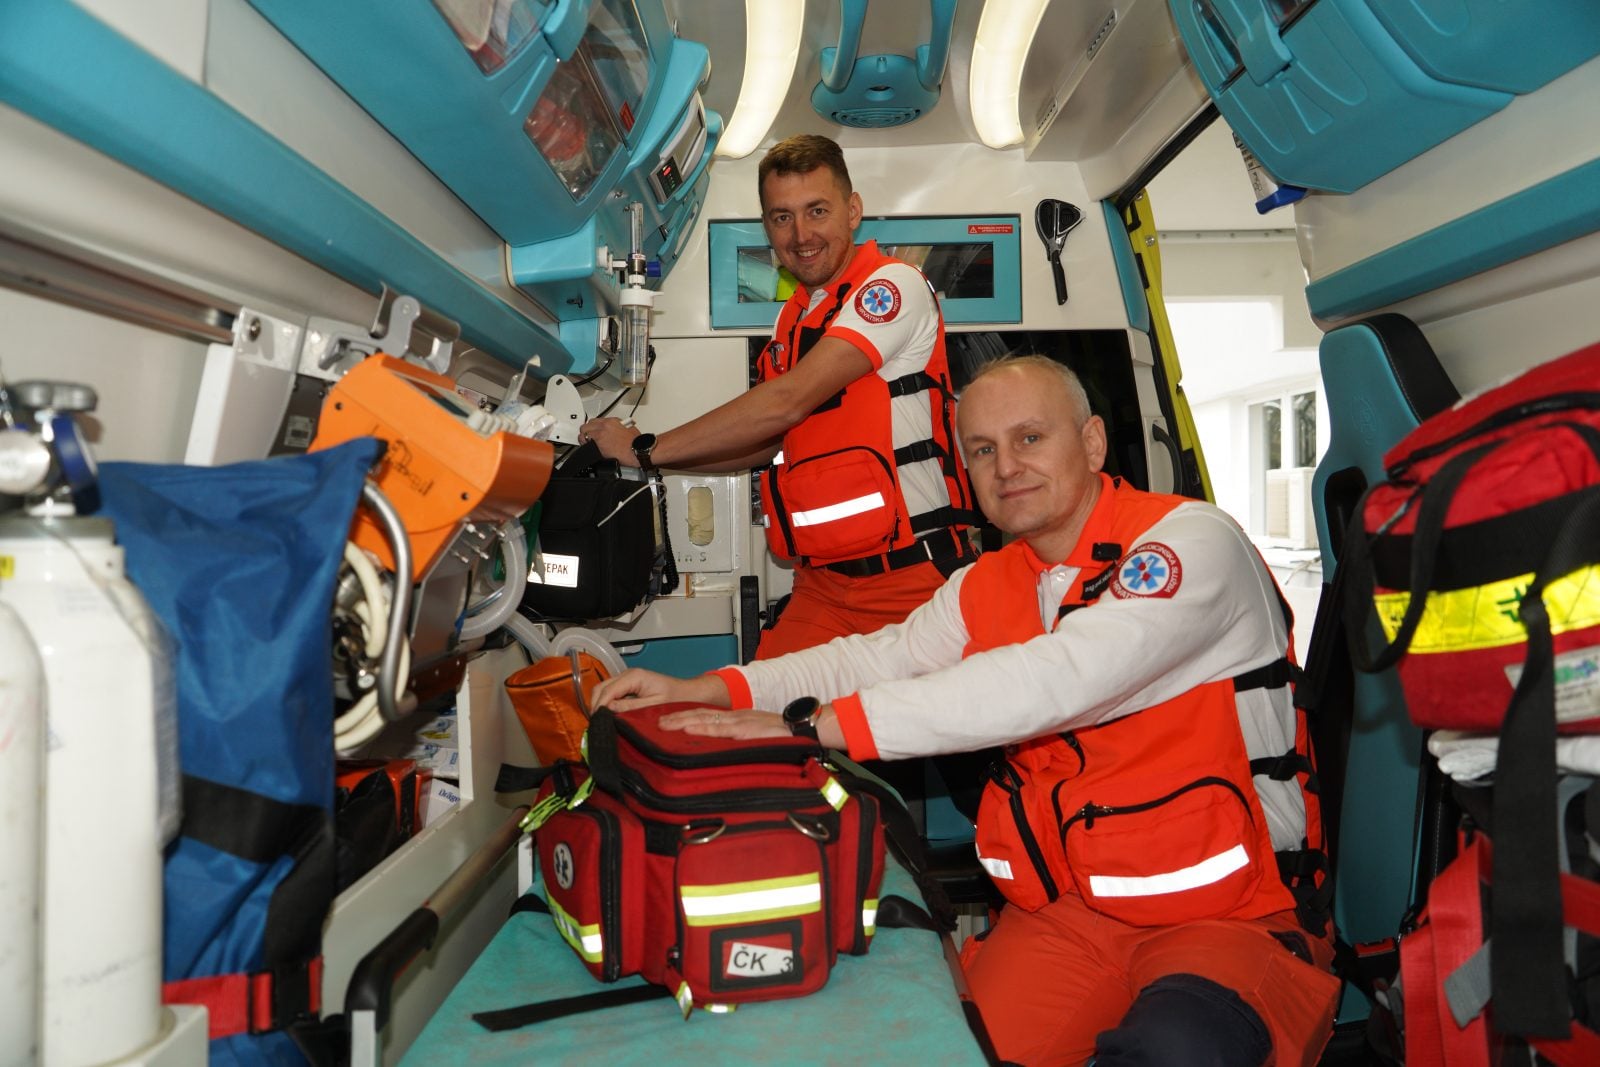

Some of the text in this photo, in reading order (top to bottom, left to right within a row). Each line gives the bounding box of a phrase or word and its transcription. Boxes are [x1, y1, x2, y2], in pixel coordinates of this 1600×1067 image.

[857, 306, 885, 322] HRVATSKA
[1136, 544, 1176, 565] MEDICINSKA
[544, 562, 569, 575] EPAK
[733, 945, 768, 972] ČK
